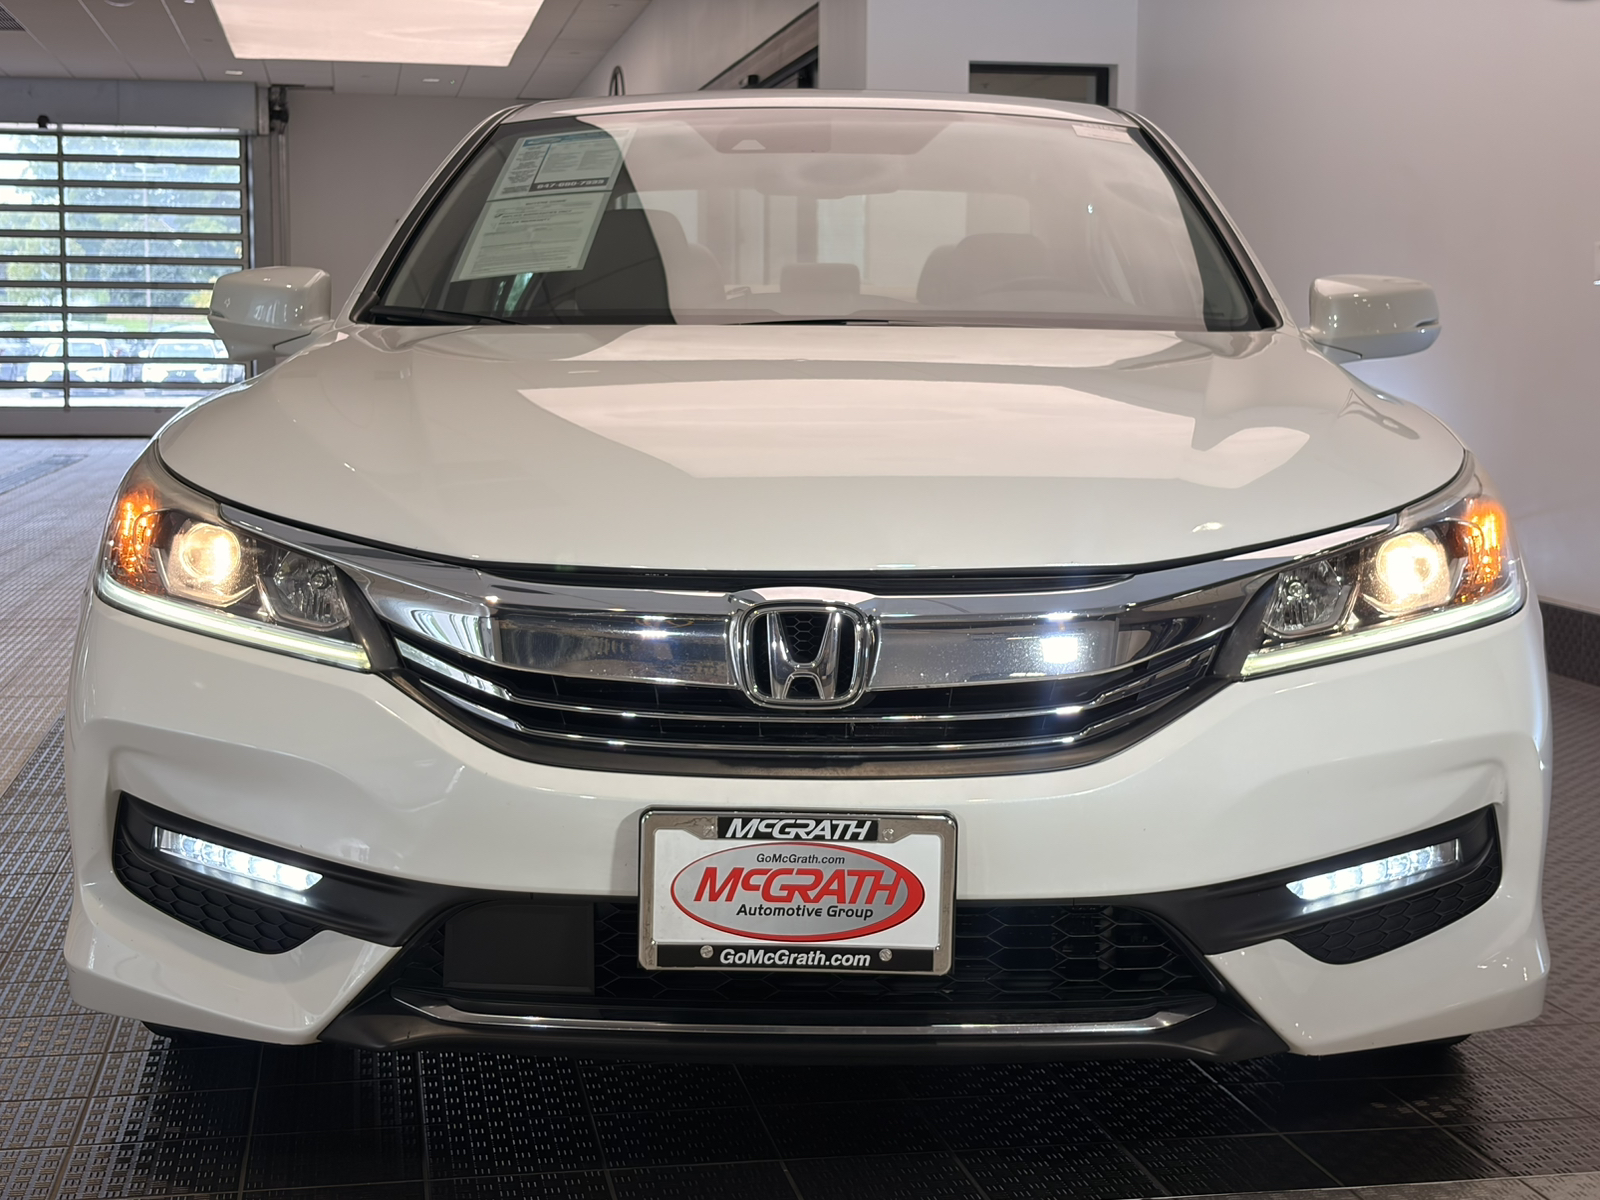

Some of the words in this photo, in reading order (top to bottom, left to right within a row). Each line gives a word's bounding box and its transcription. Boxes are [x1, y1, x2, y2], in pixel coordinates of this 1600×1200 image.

[756, 852, 846, 866] GoMcGrath.com
[736, 903, 823, 918] Automotive
[826, 905, 874, 921] Group
[719, 948, 872, 967] GoMcGrath.com
